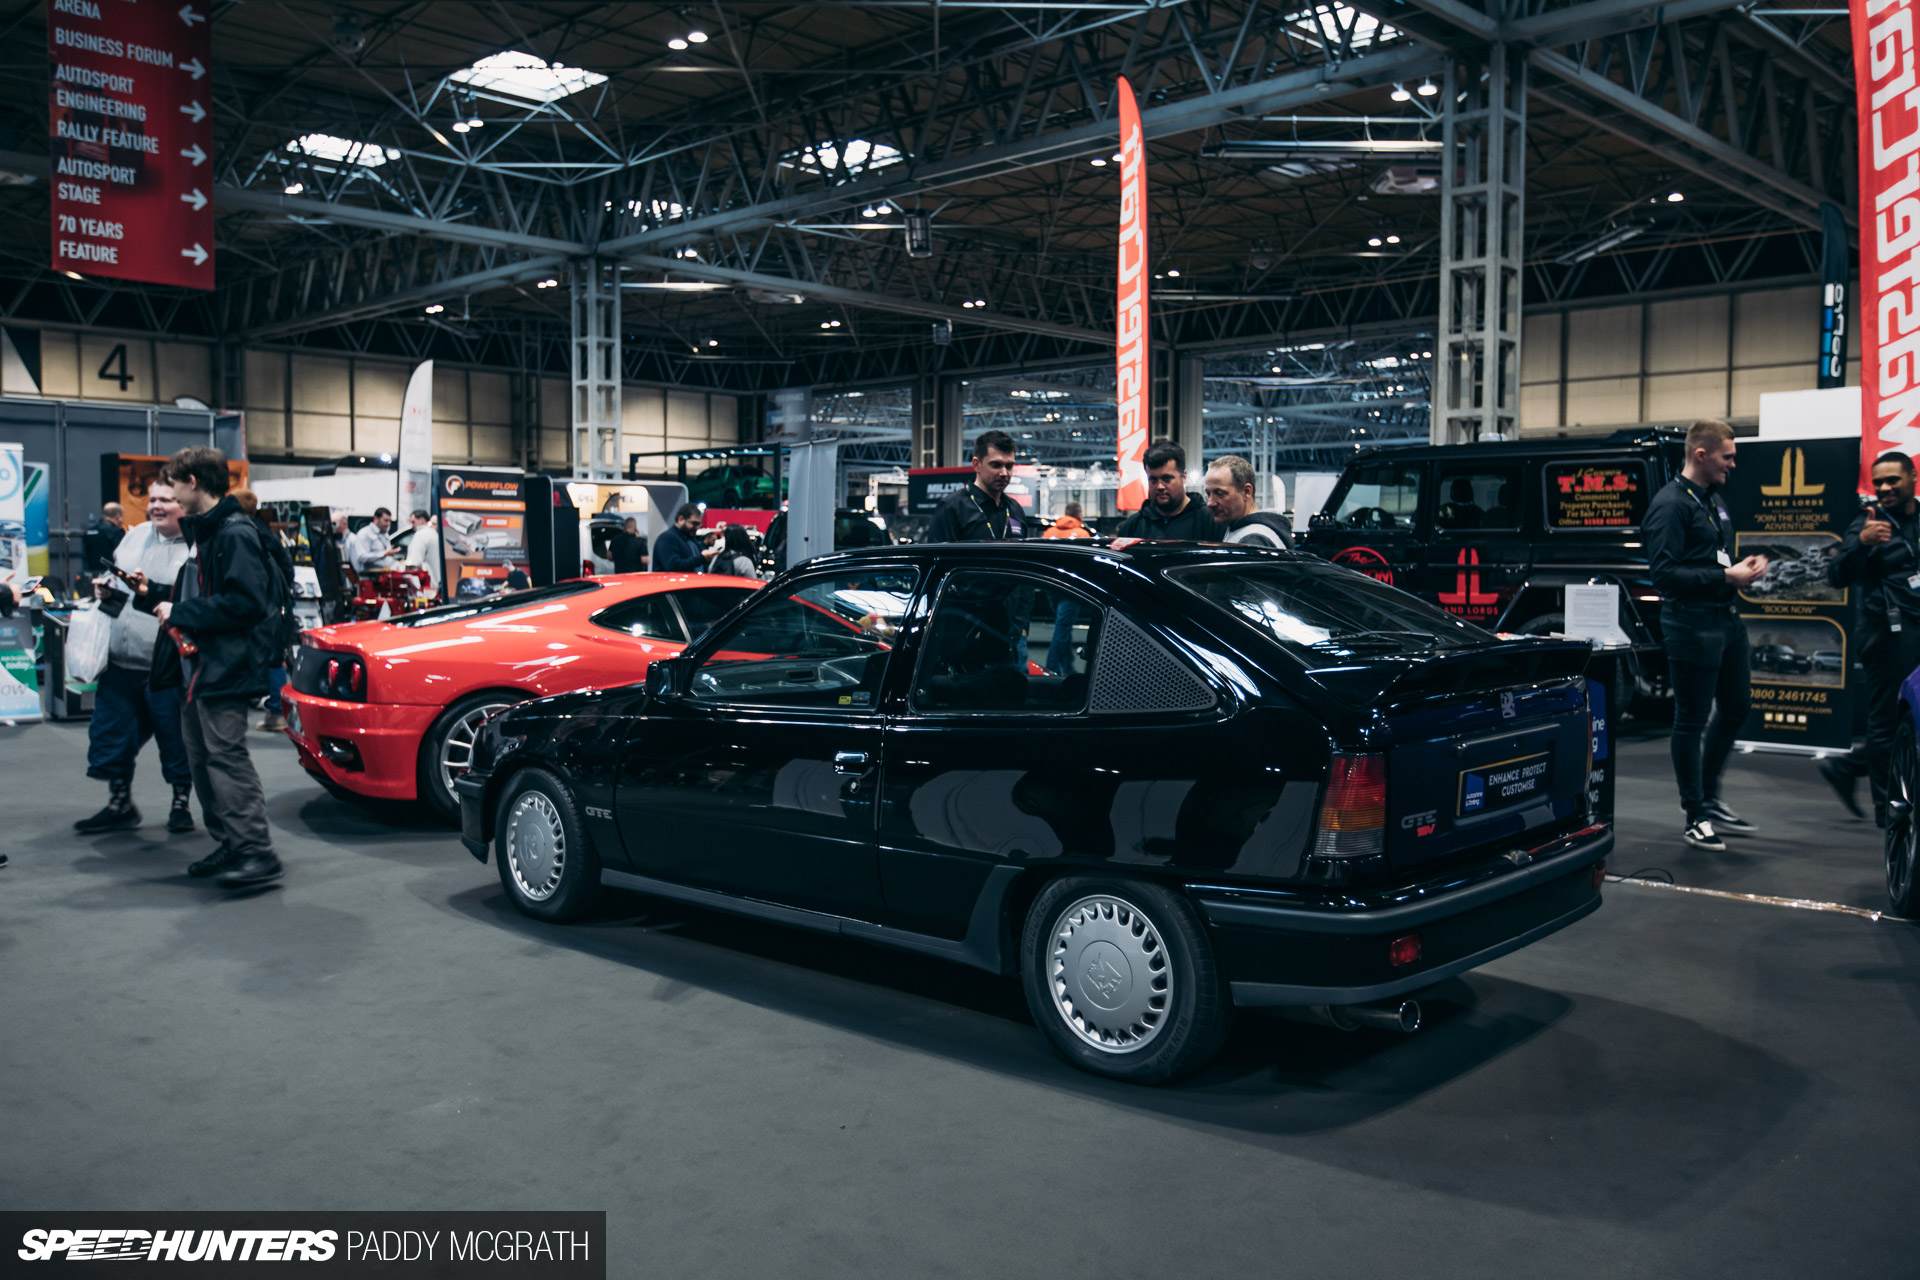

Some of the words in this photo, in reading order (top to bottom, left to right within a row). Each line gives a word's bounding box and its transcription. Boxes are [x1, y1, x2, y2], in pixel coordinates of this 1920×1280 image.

[54, 0, 102, 20] ARENA
[55, 27, 124, 57] BUSINESS
[126, 44, 174, 68] FORUM
[55, 63, 135, 94] AUTOSPORT
[56, 90, 147, 122] ENGINEERING
[57, 120, 100, 145] RALLY
[102, 129, 160, 154] FEATURE
[57, 156, 136, 185] AUTOSPORT
[58, 183, 102, 205] STAGE
[58, 214, 76, 233] 70
[79, 217, 124, 240] YEARS
[59, 240, 118, 264] FEATURE
[97, 343, 134, 391] 4
[465, 481, 519, 491] POWERFLOW
[1557, 475, 1637, 493] T.M.S.
[1560, 501, 1591, 510] Property
[1575, 492, 1620, 500] Commercial
[1762, 499, 1788, 507] LAND
[1792, 499, 1824, 507] LORDS
[1566, 510, 1579, 518] For
[1580, 509, 1595, 518] Sale
[1778, 513, 1794, 522] THE
[1795, 513, 1830, 523] UNIQUE
[1467, 606, 1499, 616] LORDS
[1777, 690, 1828, 704] 2461745
[1591, 716, 1605, 732] ine
[1488, 769, 1520, 786] ENHANCE
[1521, 761, 1547, 779] PROTECT
[1501, 778, 1535, 797] CUSTOMISE
[585, 806, 613, 820] GTE
[1401, 809, 1437, 830] GTE
